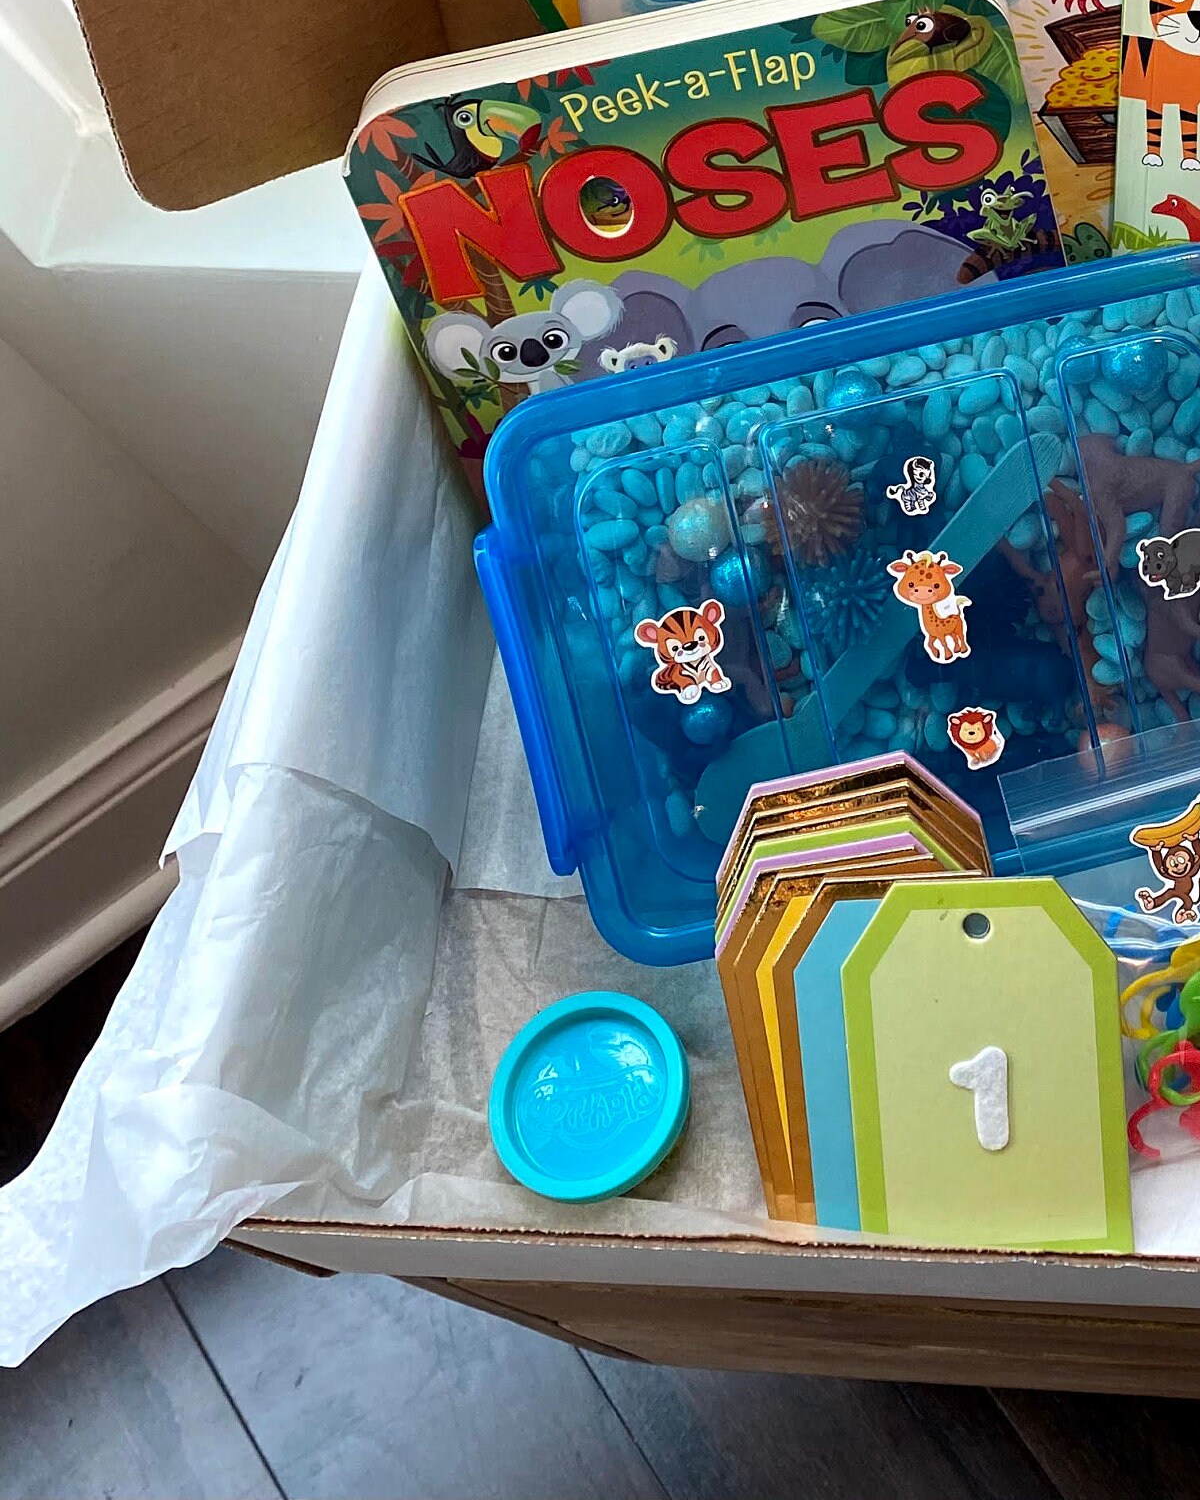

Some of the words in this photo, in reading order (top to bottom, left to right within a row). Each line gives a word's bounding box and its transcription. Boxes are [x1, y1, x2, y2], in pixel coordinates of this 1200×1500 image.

[559, 48, 817, 133] Peek-a-Flap
[399, 71, 1001, 302] NOSES
[948, 1045, 1010, 1152] 1
